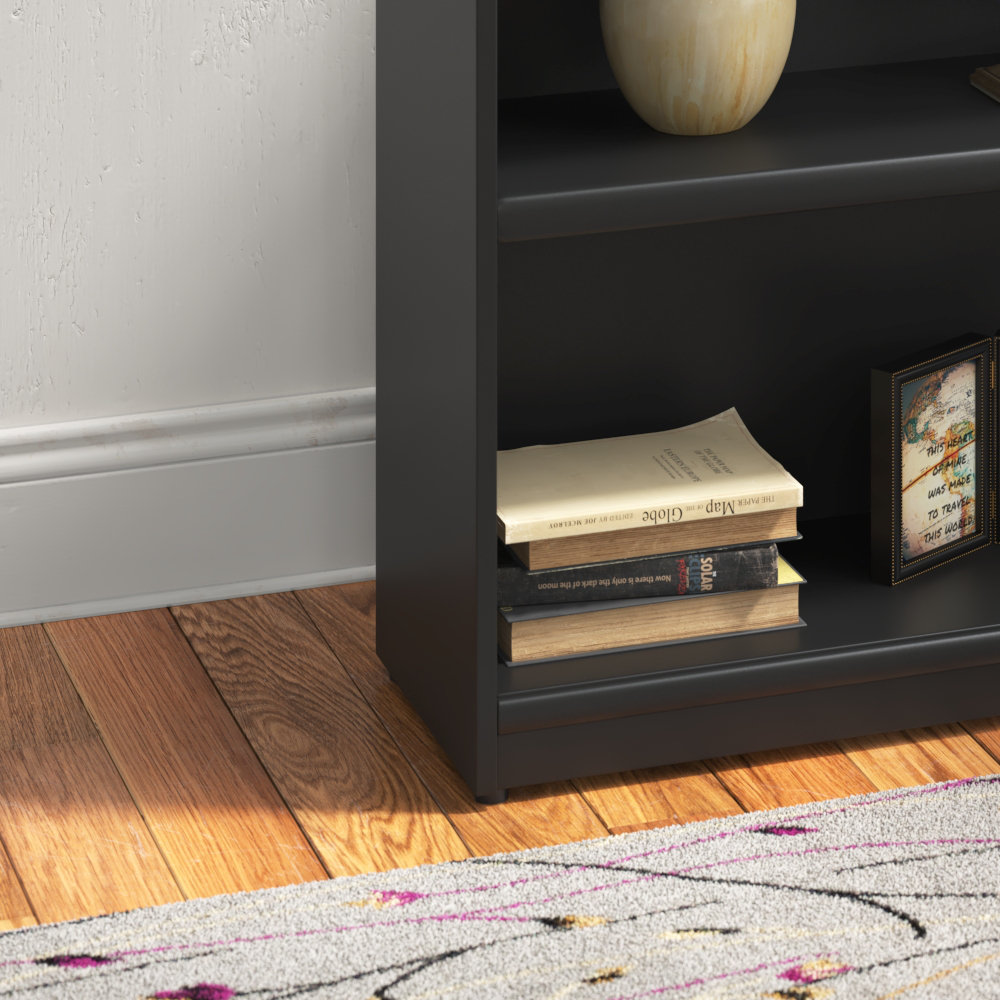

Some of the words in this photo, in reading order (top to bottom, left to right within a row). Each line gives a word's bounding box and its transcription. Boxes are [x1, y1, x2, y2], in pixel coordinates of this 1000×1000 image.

[928, 483, 947, 499] WAS
[737, 496, 760, 506] PAPER
[705, 498, 735, 515] Map
[928, 508, 939, 520] TO
[941, 495, 971, 515] TRAVEL
[584, 517, 597, 525] JOE
[642, 507, 683, 525] Globe
[924, 527, 943, 543] THIS
[655, 574, 672, 584] Now
[700, 556, 713, 592] SOLAR
[581, 579, 598, 588] dark
[599, 578, 611, 587] the
[612, 576, 627, 587] only
[629, 576, 635, 585] is
[635, 575, 654, 585] there
[559, 582, 571, 590] the
[573, 581, 581, 590] of
